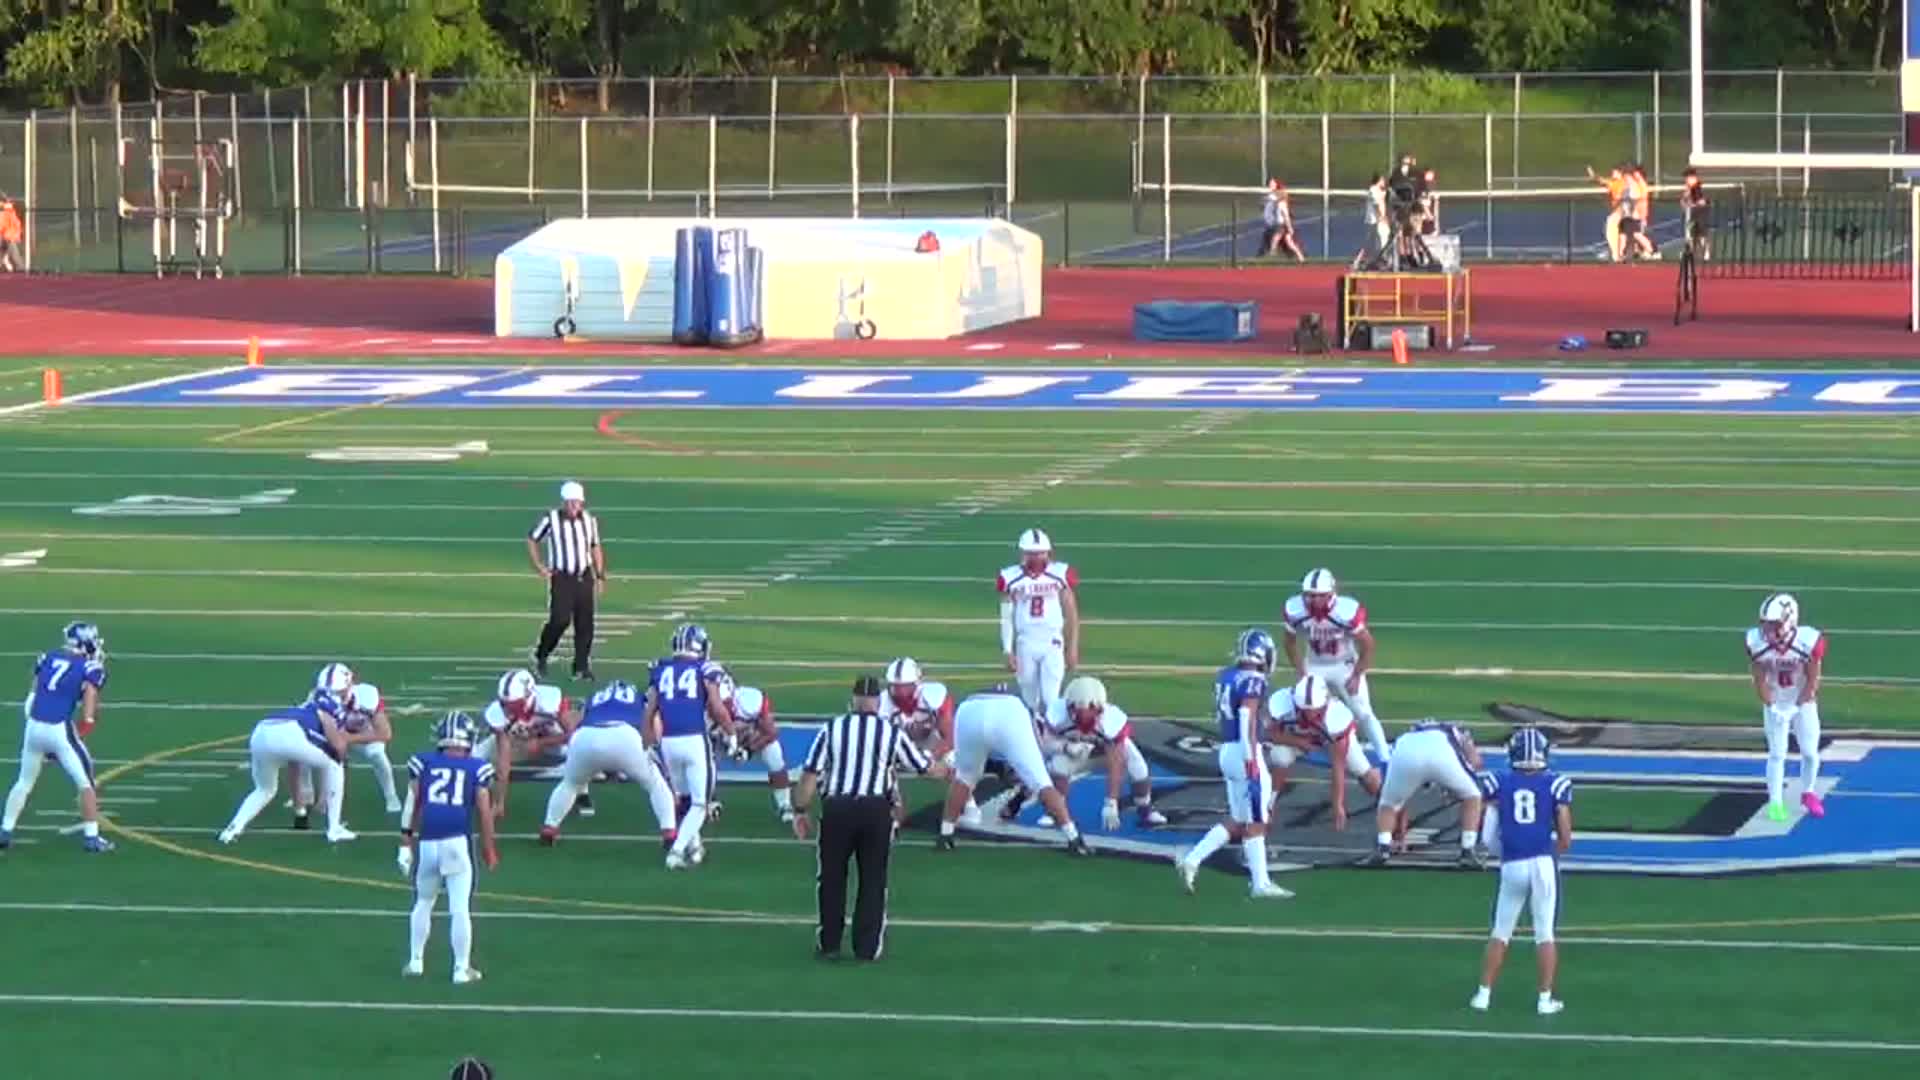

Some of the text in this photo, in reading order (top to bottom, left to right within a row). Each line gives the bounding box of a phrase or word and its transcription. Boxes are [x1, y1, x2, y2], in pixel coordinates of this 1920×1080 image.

[180, 373, 1362, 400] BLUE
[47, 658, 71, 691] 7
[658, 665, 698, 700] 44
[427, 767, 467, 808] 21
[1512, 789, 1537, 825] 8
